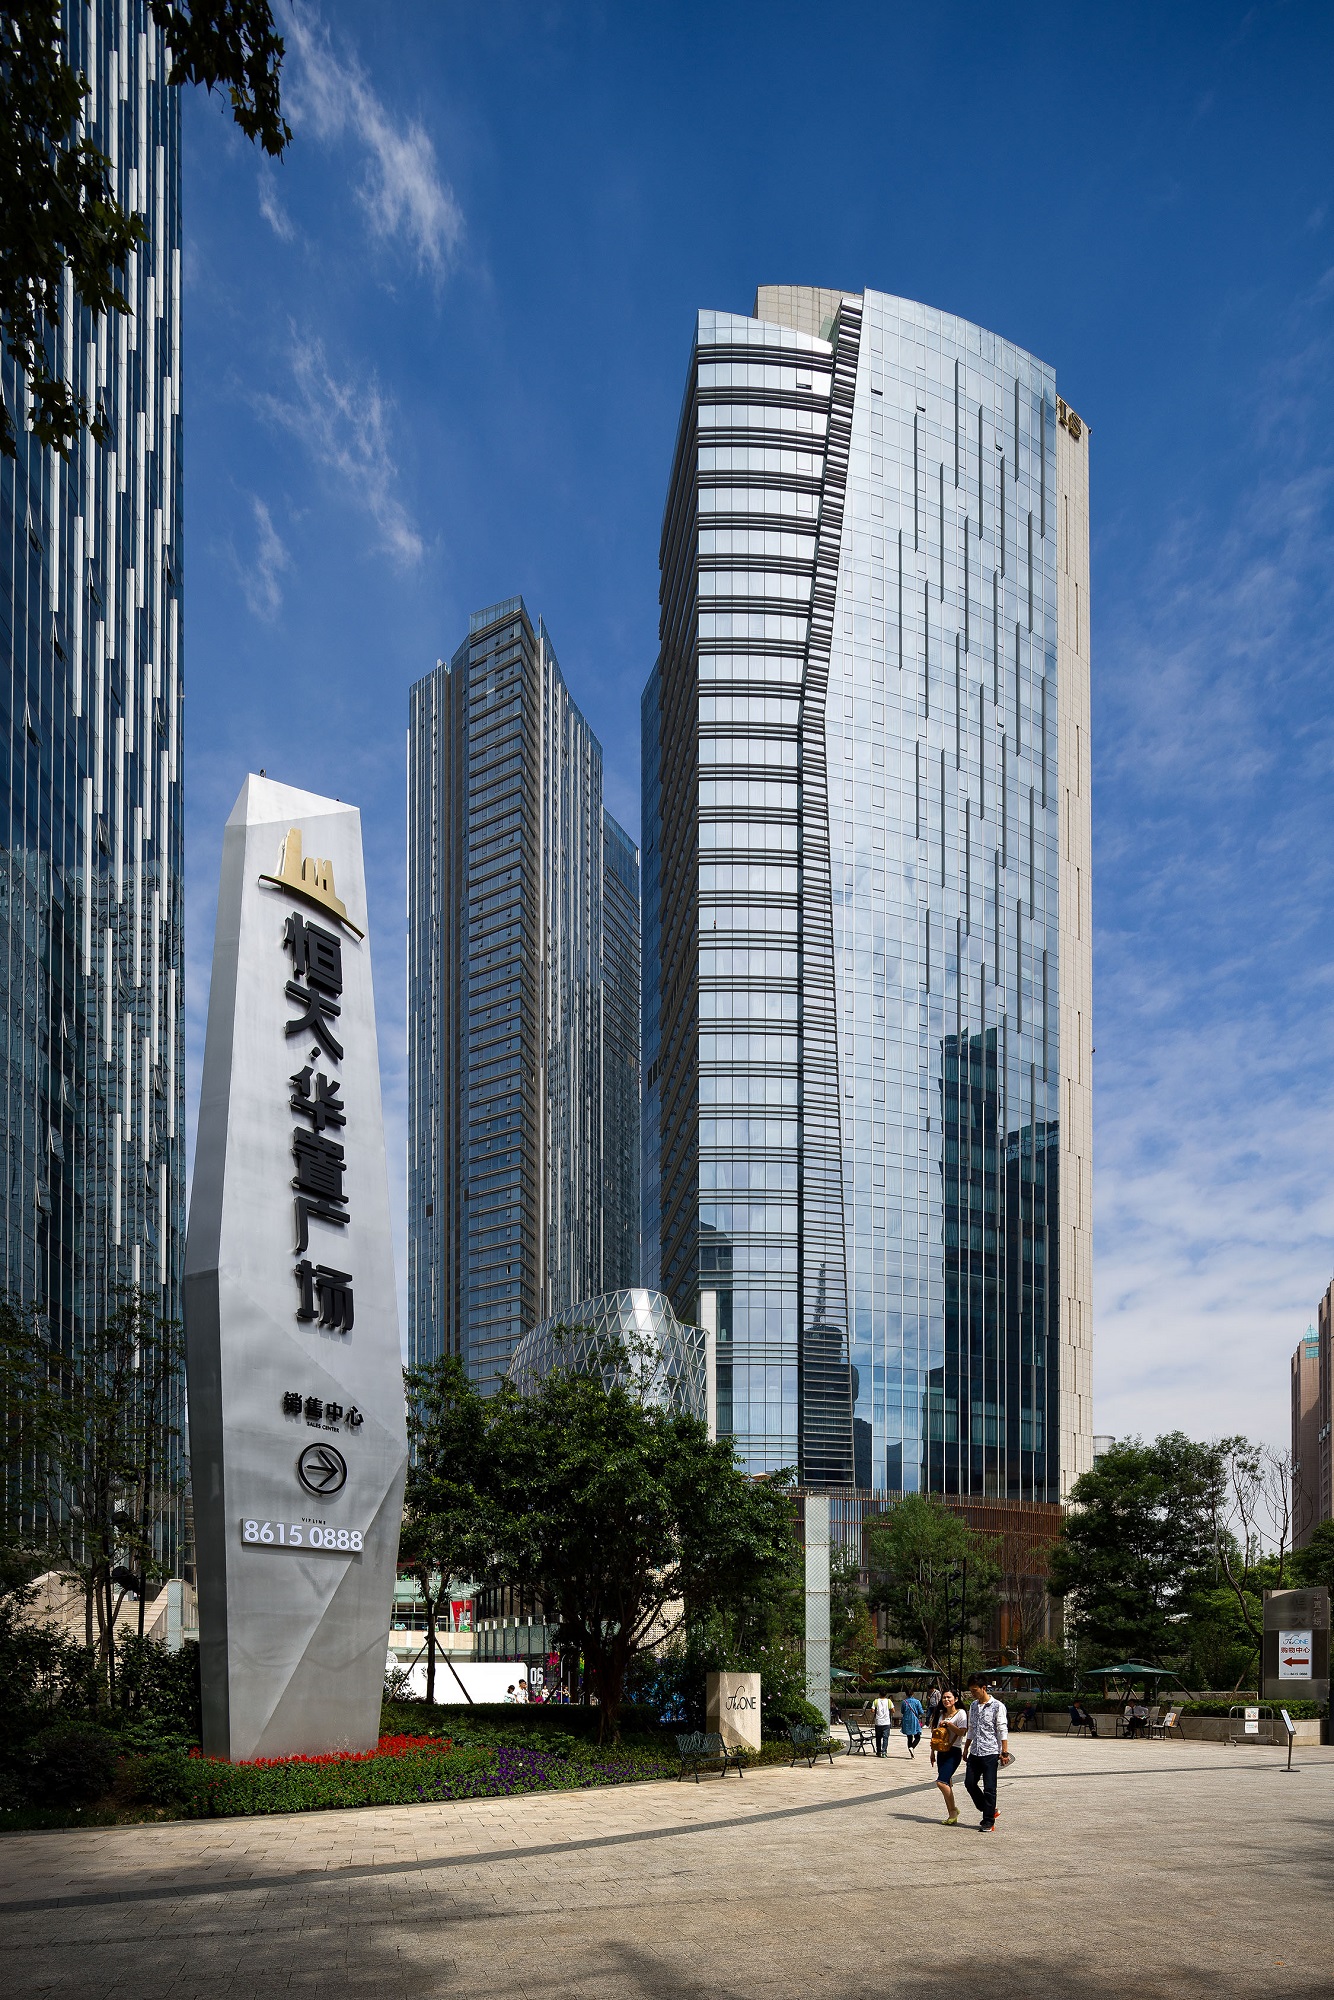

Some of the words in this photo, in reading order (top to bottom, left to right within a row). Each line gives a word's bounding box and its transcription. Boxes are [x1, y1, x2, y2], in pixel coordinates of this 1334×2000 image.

[307, 1421, 321, 1429] SALES
[322, 1425, 339, 1433] CENTER
[244, 1520, 303, 1546] 8615
[309, 1526, 363, 1551] 0888
[530, 1667, 544, 1684] 06
